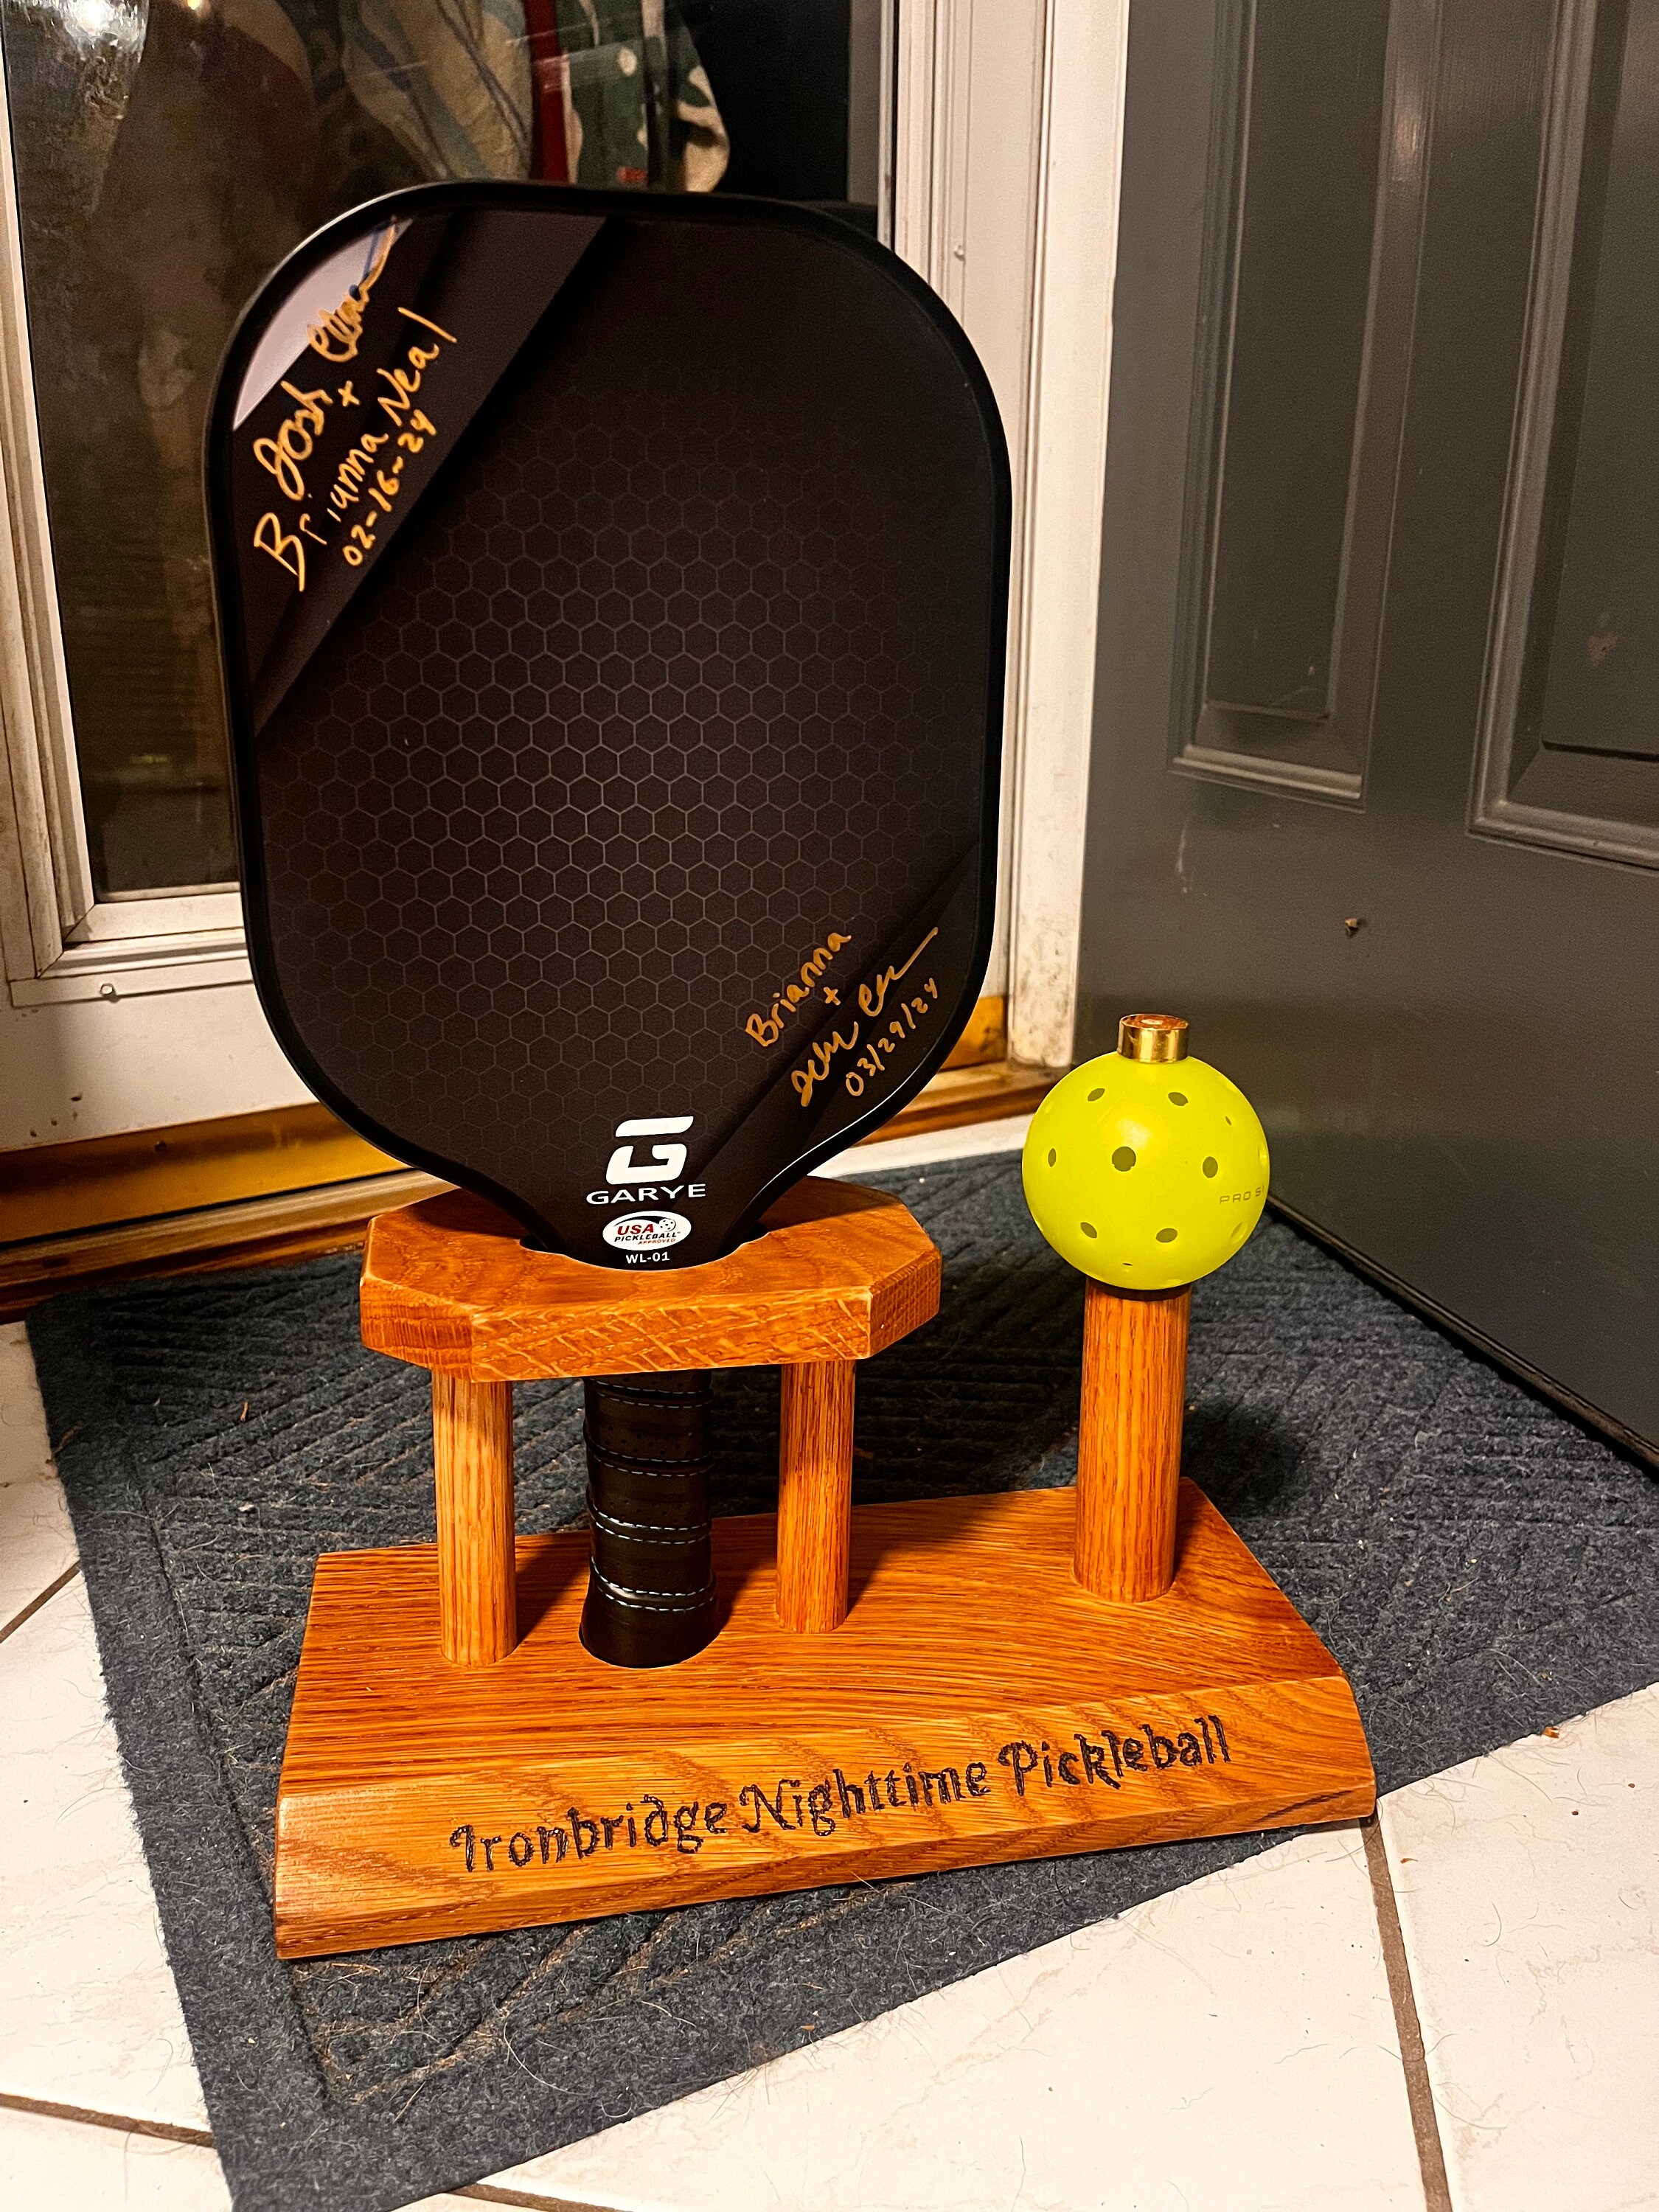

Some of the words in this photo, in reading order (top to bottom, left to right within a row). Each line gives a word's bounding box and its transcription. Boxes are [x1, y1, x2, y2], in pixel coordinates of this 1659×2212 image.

[253, 433, 389, 592] Brianna
[377, 306, 457, 426] Neal
[745, 932, 852, 1047] Brianna
[845, 977, 938, 1096] 03/29/24
[585, 1183, 706, 1205] GARYE
[1220, 1191, 1251, 1205] PRO
[614, 1232, 677, 1242] PICKLEBALL
[617, 1223, 654, 1236] USA
[625, 1251, 670, 1264] WL-01
[449, 1793, 728, 1873] Ironbridge
[739, 1761, 991, 1837] Nighttime
[997, 1714, 1232, 1797] Pickleball
